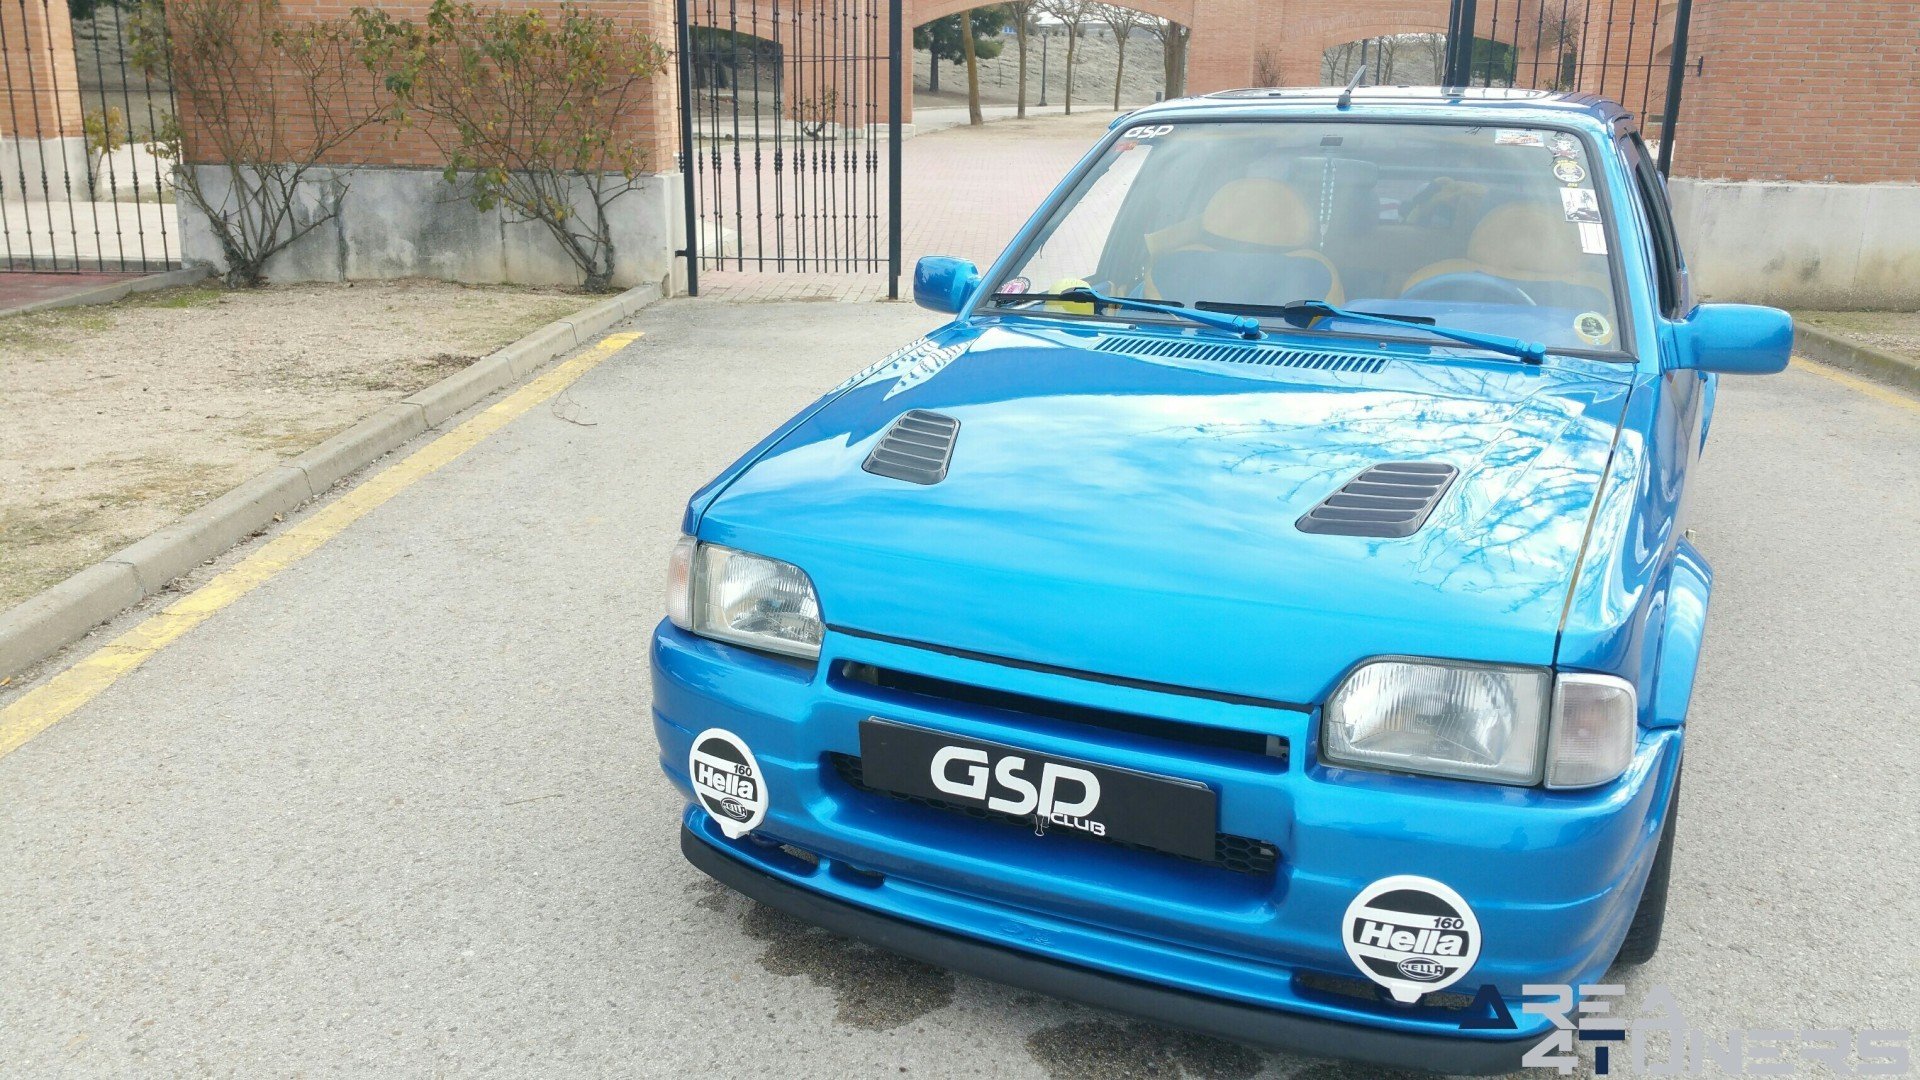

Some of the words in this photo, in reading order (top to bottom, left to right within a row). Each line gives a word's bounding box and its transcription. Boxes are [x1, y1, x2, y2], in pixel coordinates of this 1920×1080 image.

[734, 764, 752, 777] 160
[698, 763, 754, 800] Hella
[1051, 812, 1106, 836] CLUB
[1433, 917, 1464, 929] 160
[1359, 921, 1463, 956] Hella
[1401, 962, 1444, 975] HELLA
